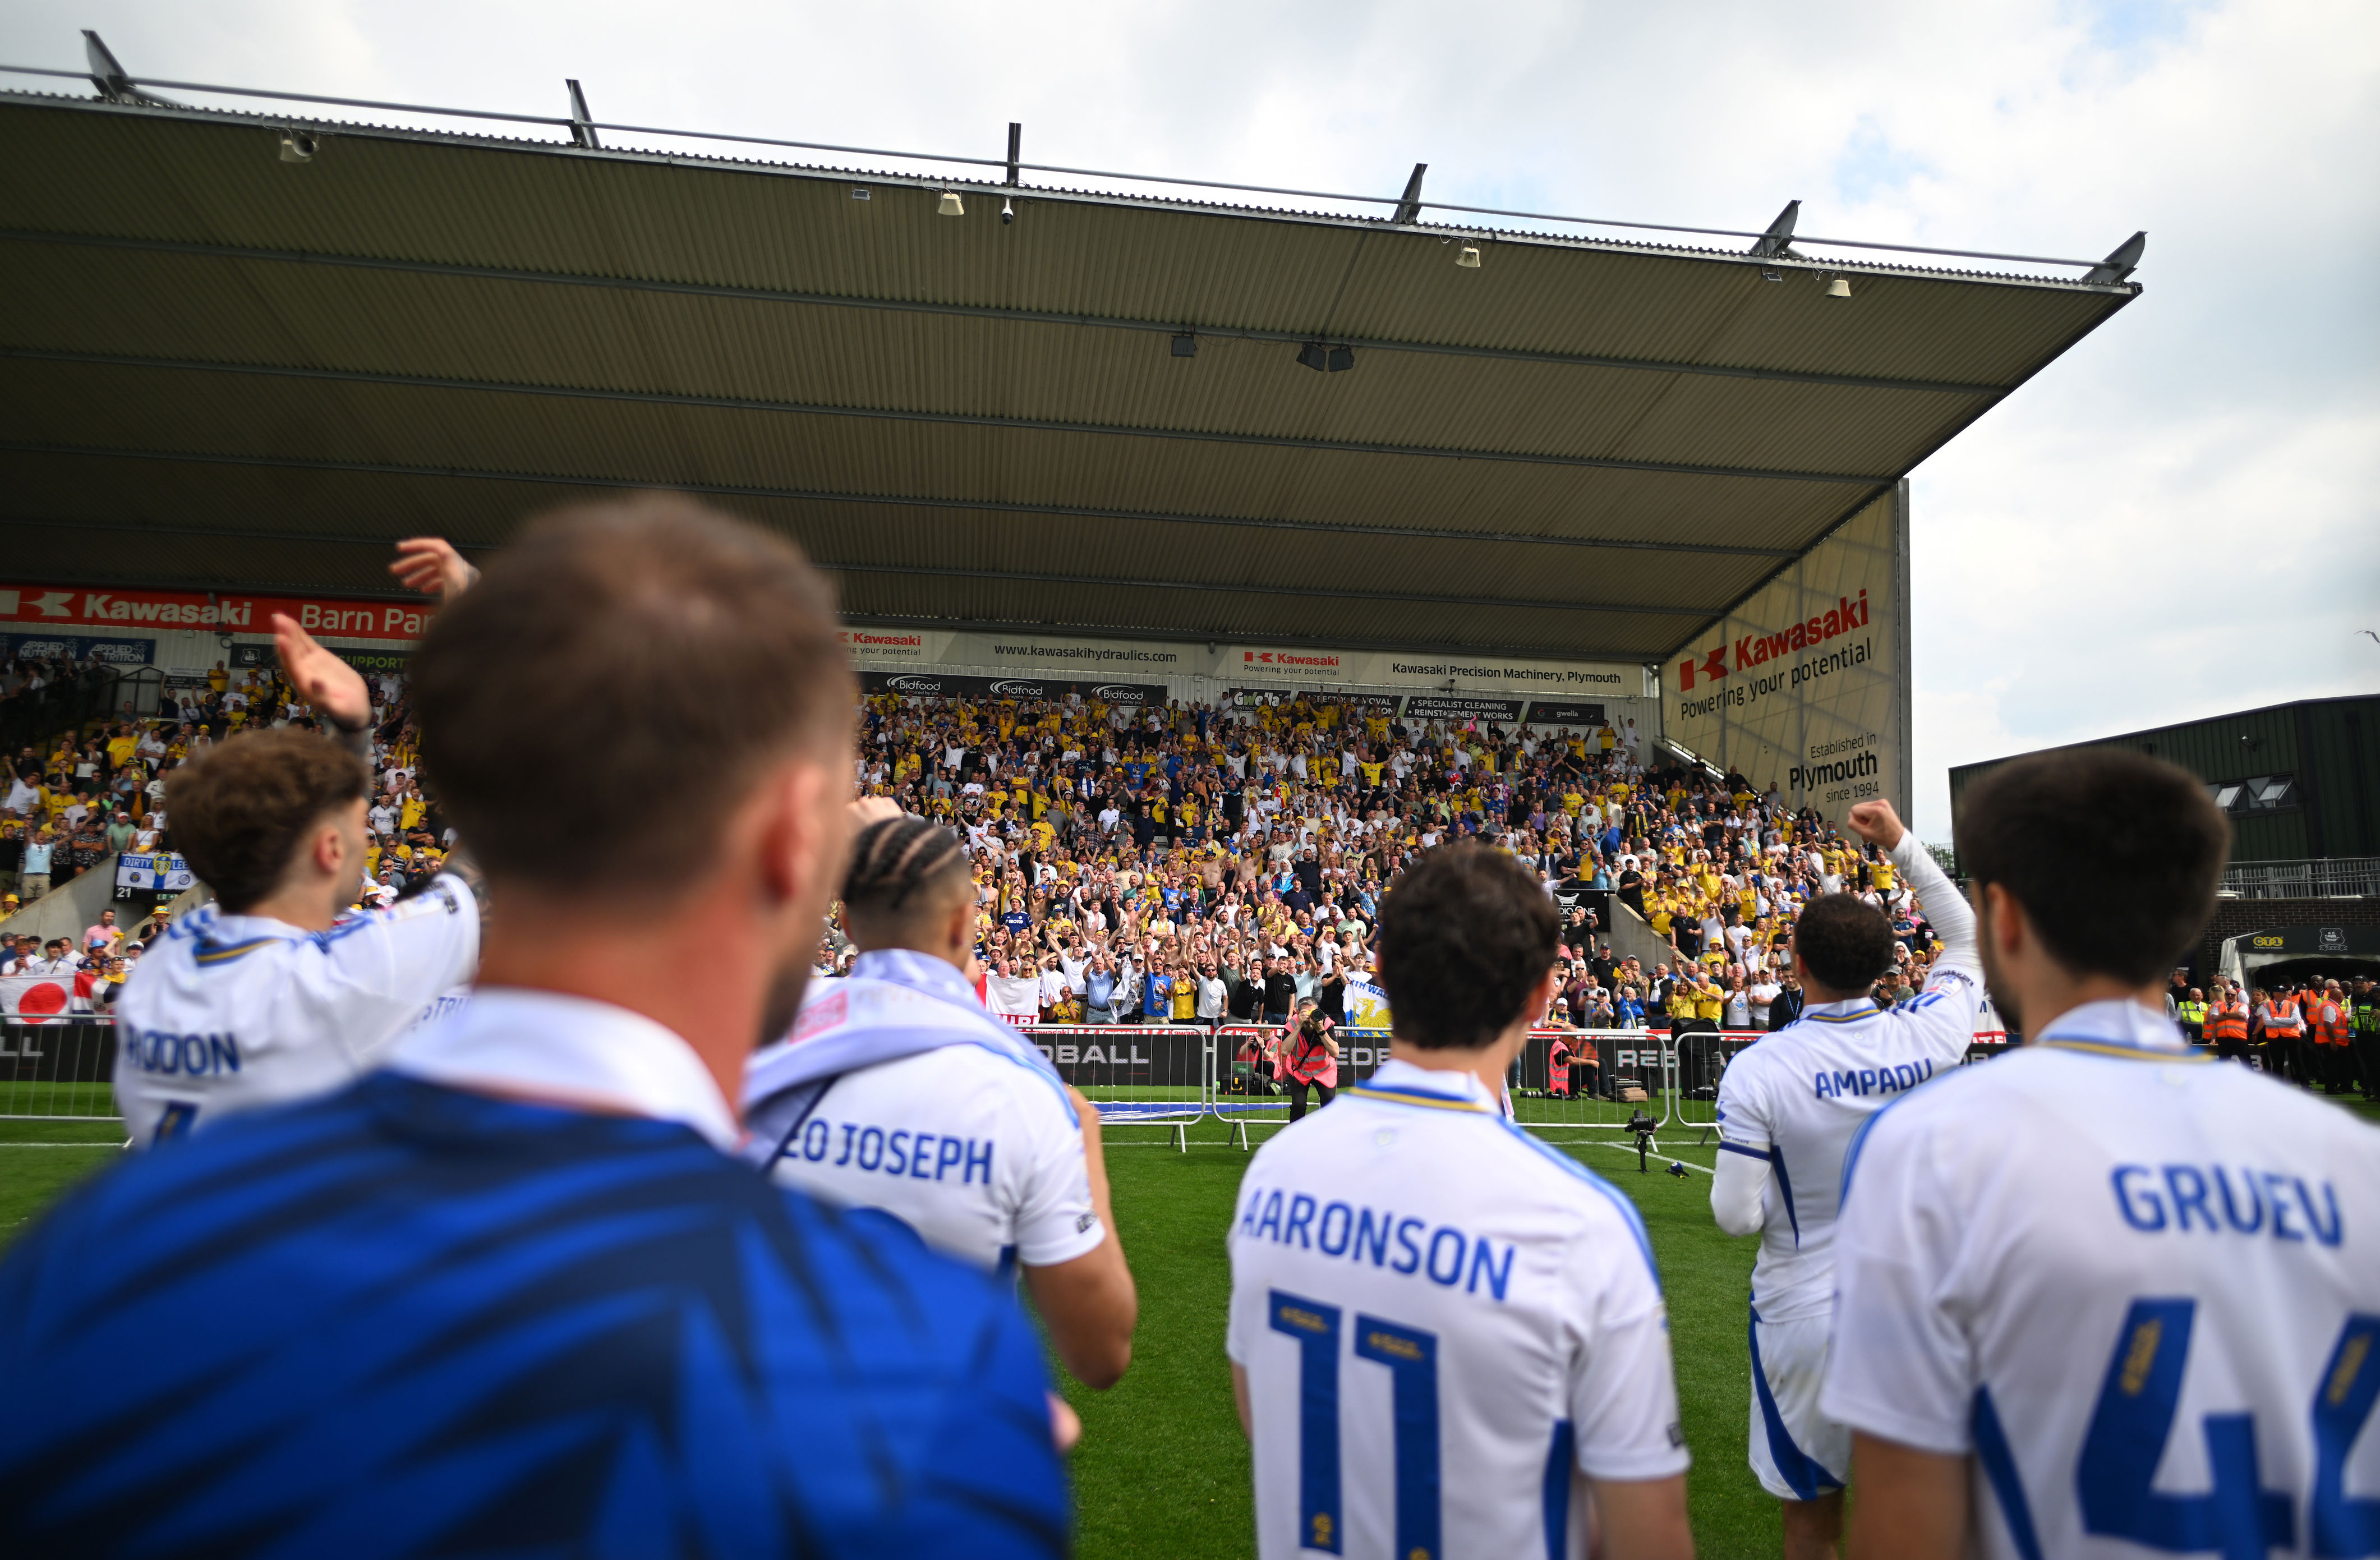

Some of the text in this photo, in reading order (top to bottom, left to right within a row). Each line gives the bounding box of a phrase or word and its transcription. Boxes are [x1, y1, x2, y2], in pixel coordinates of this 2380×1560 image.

[84, 593, 252, 625] Kawasaki
[300, 604, 438, 634] Barn Par
[854, 633, 920, 646] Kawasaki
[1735, 588, 1868, 672] Kawasaki
[21, 641, 65, 651] APPLIED
[90, 644, 133, 654] APPLIED
[995, 643, 1177, 663] www.kawasakihydraulics.com
[88, 652, 145, 662] NTRITION
[1277, 653, 1339, 666] Kawasaki
[1244, 665, 1281, 674] Powering
[1392, 663, 1621, 684] Kawasaki Precision Machinery, Plymouth
[1681, 637, 1871, 721] Powering your potential
[899, 680, 941, 691] Bidfood
[1002, 684, 1043, 695] Bidfood
[1104, 689, 1144, 700] Bidfood
[1417, 700, 1507, 710] SPECIALIST CLEANING
[1483, 711, 1513, 720] WORKS
[1811, 732, 1876, 759] Established in
[1789, 750, 1877, 792] Plymouth
[1826, 781, 1879, 803] since 1994
[124, 857, 189, 869] DIRTY LEE
[117, 887, 132, 898] 21
[1816, 1058, 1932, 1098] AMPADU
[835, 1124, 993, 1184] JOSEPH
[2110, 1163, 2345, 1249] GRUEV
[1241, 1188, 1514, 1302] AARONSON
[1269, 1288, 1442, 1560] 11
